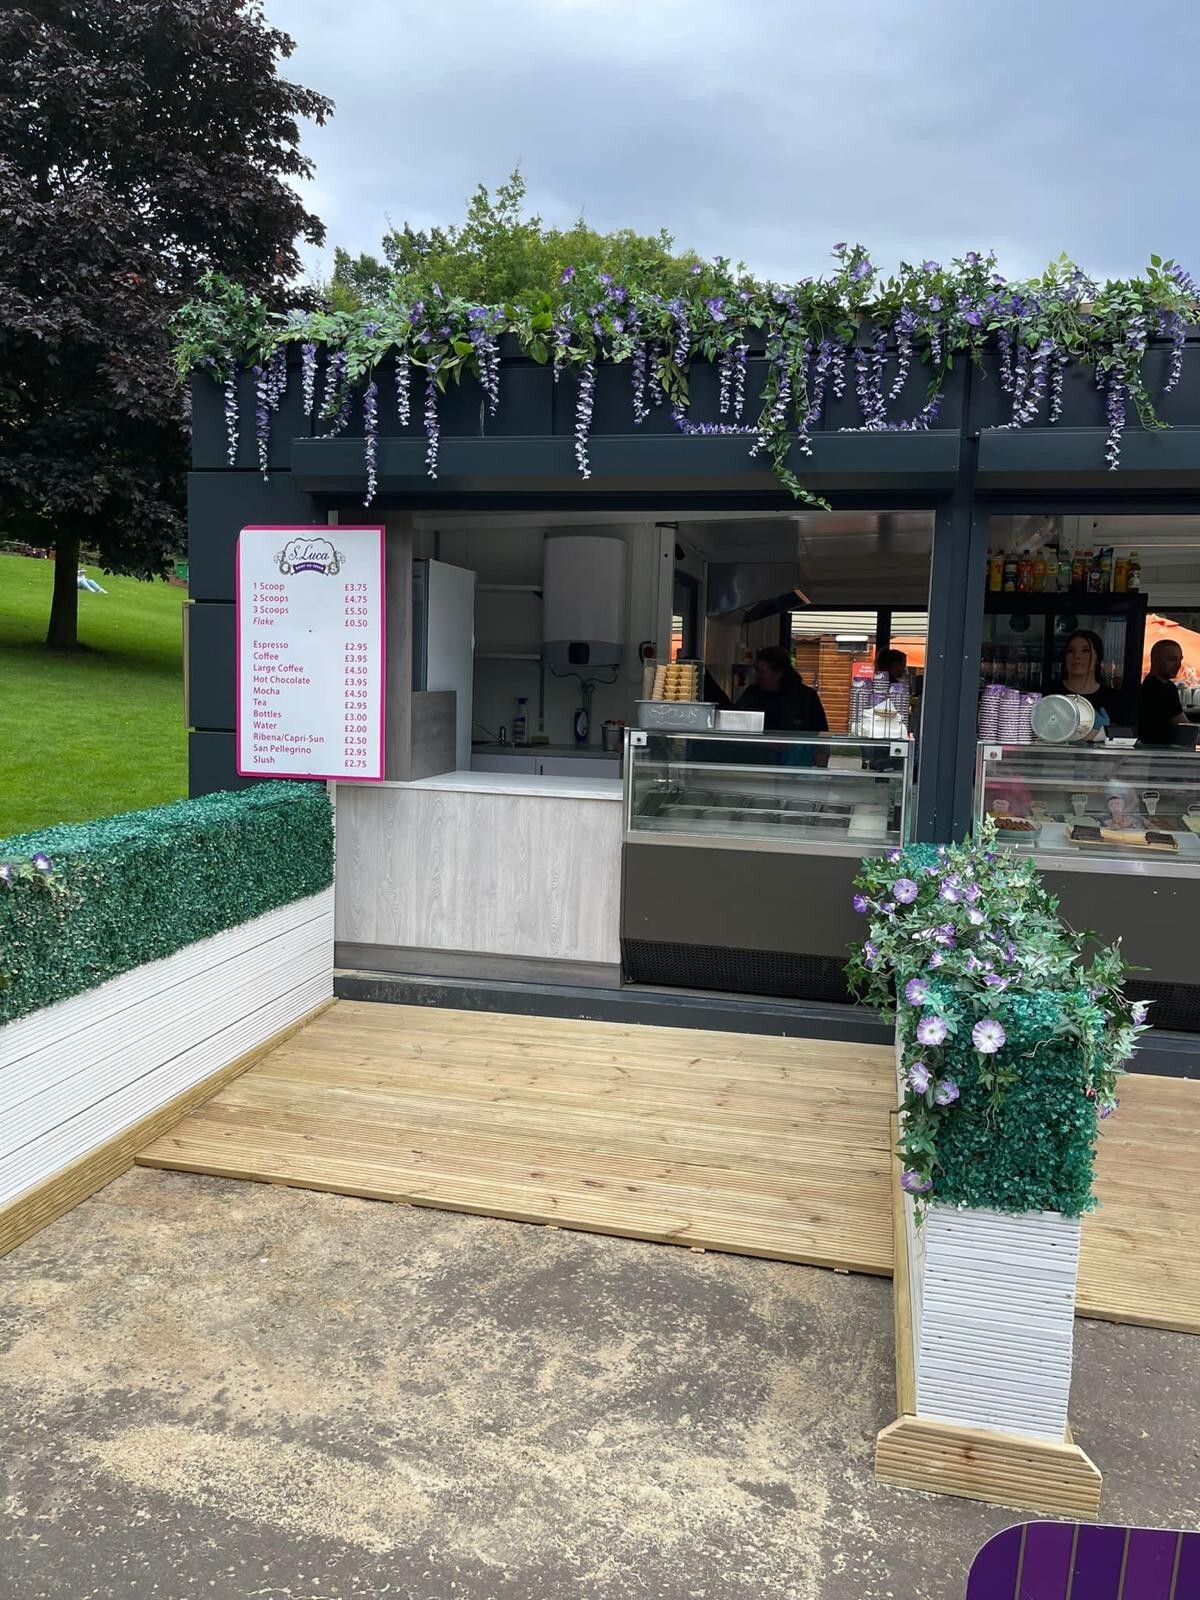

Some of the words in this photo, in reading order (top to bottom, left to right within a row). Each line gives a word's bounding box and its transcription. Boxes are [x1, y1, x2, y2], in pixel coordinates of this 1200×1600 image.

[260, 583, 284, 591] Scoop
[260, 594, 288, 603] Scoops
[260, 606, 289, 614] Scoops
[254, 641, 288, 650] Espresso
[254, 664, 276, 673] Large
[254, 734, 324, 743] Ribena/Capri-Sun
[270, 746, 311, 755] Pellegrino
